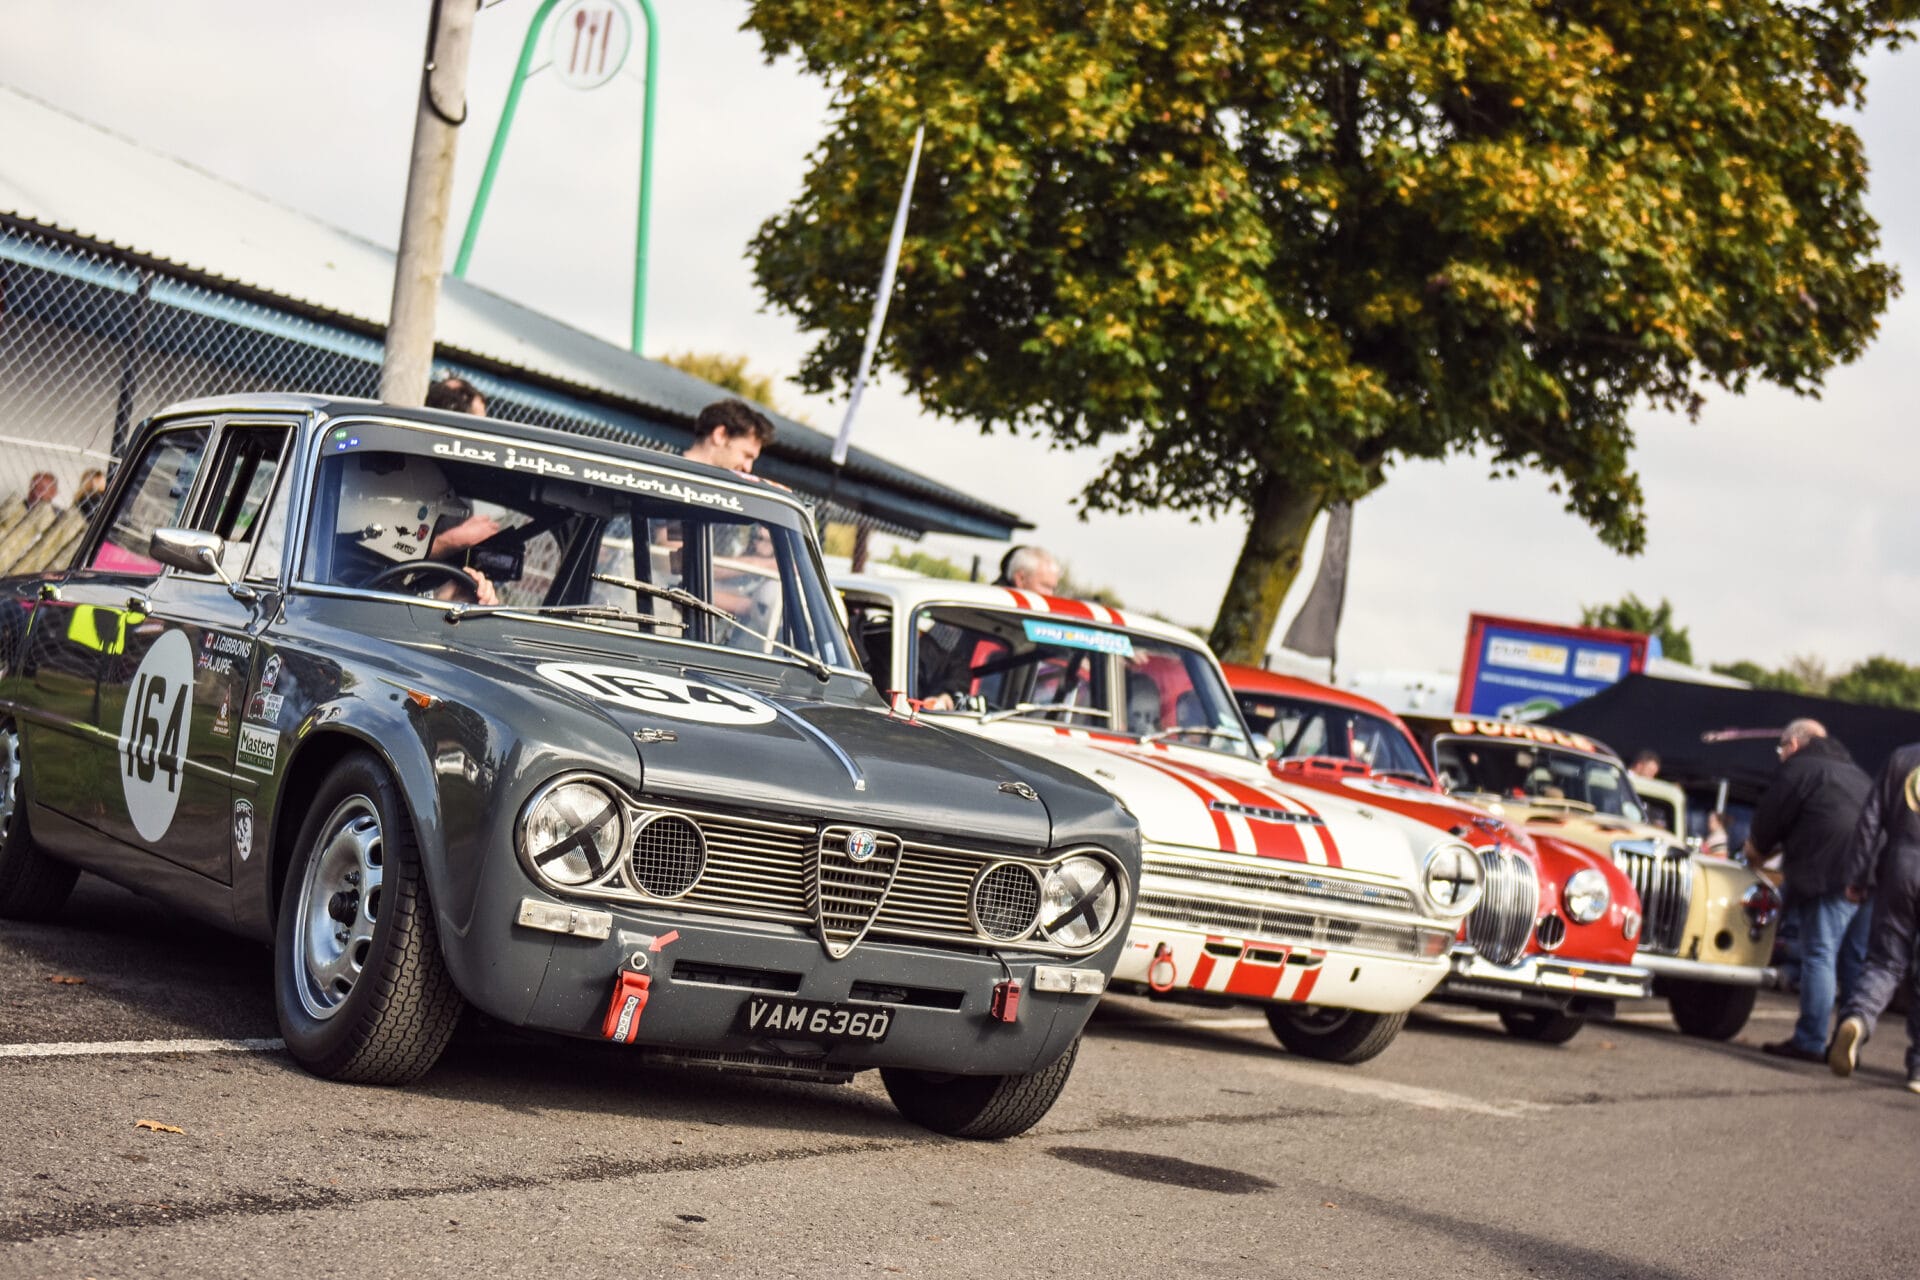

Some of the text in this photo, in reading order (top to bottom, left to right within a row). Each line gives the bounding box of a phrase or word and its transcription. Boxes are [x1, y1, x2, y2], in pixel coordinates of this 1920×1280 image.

[433, 441, 745, 511] alex jupe motorsport
[213, 634, 252, 658] J.GIBBONS
[205, 655, 232, 675] A.JUPE
[558, 669, 758, 714] 164
[127, 673, 189, 793] 164
[240, 730, 275, 758] Masters
